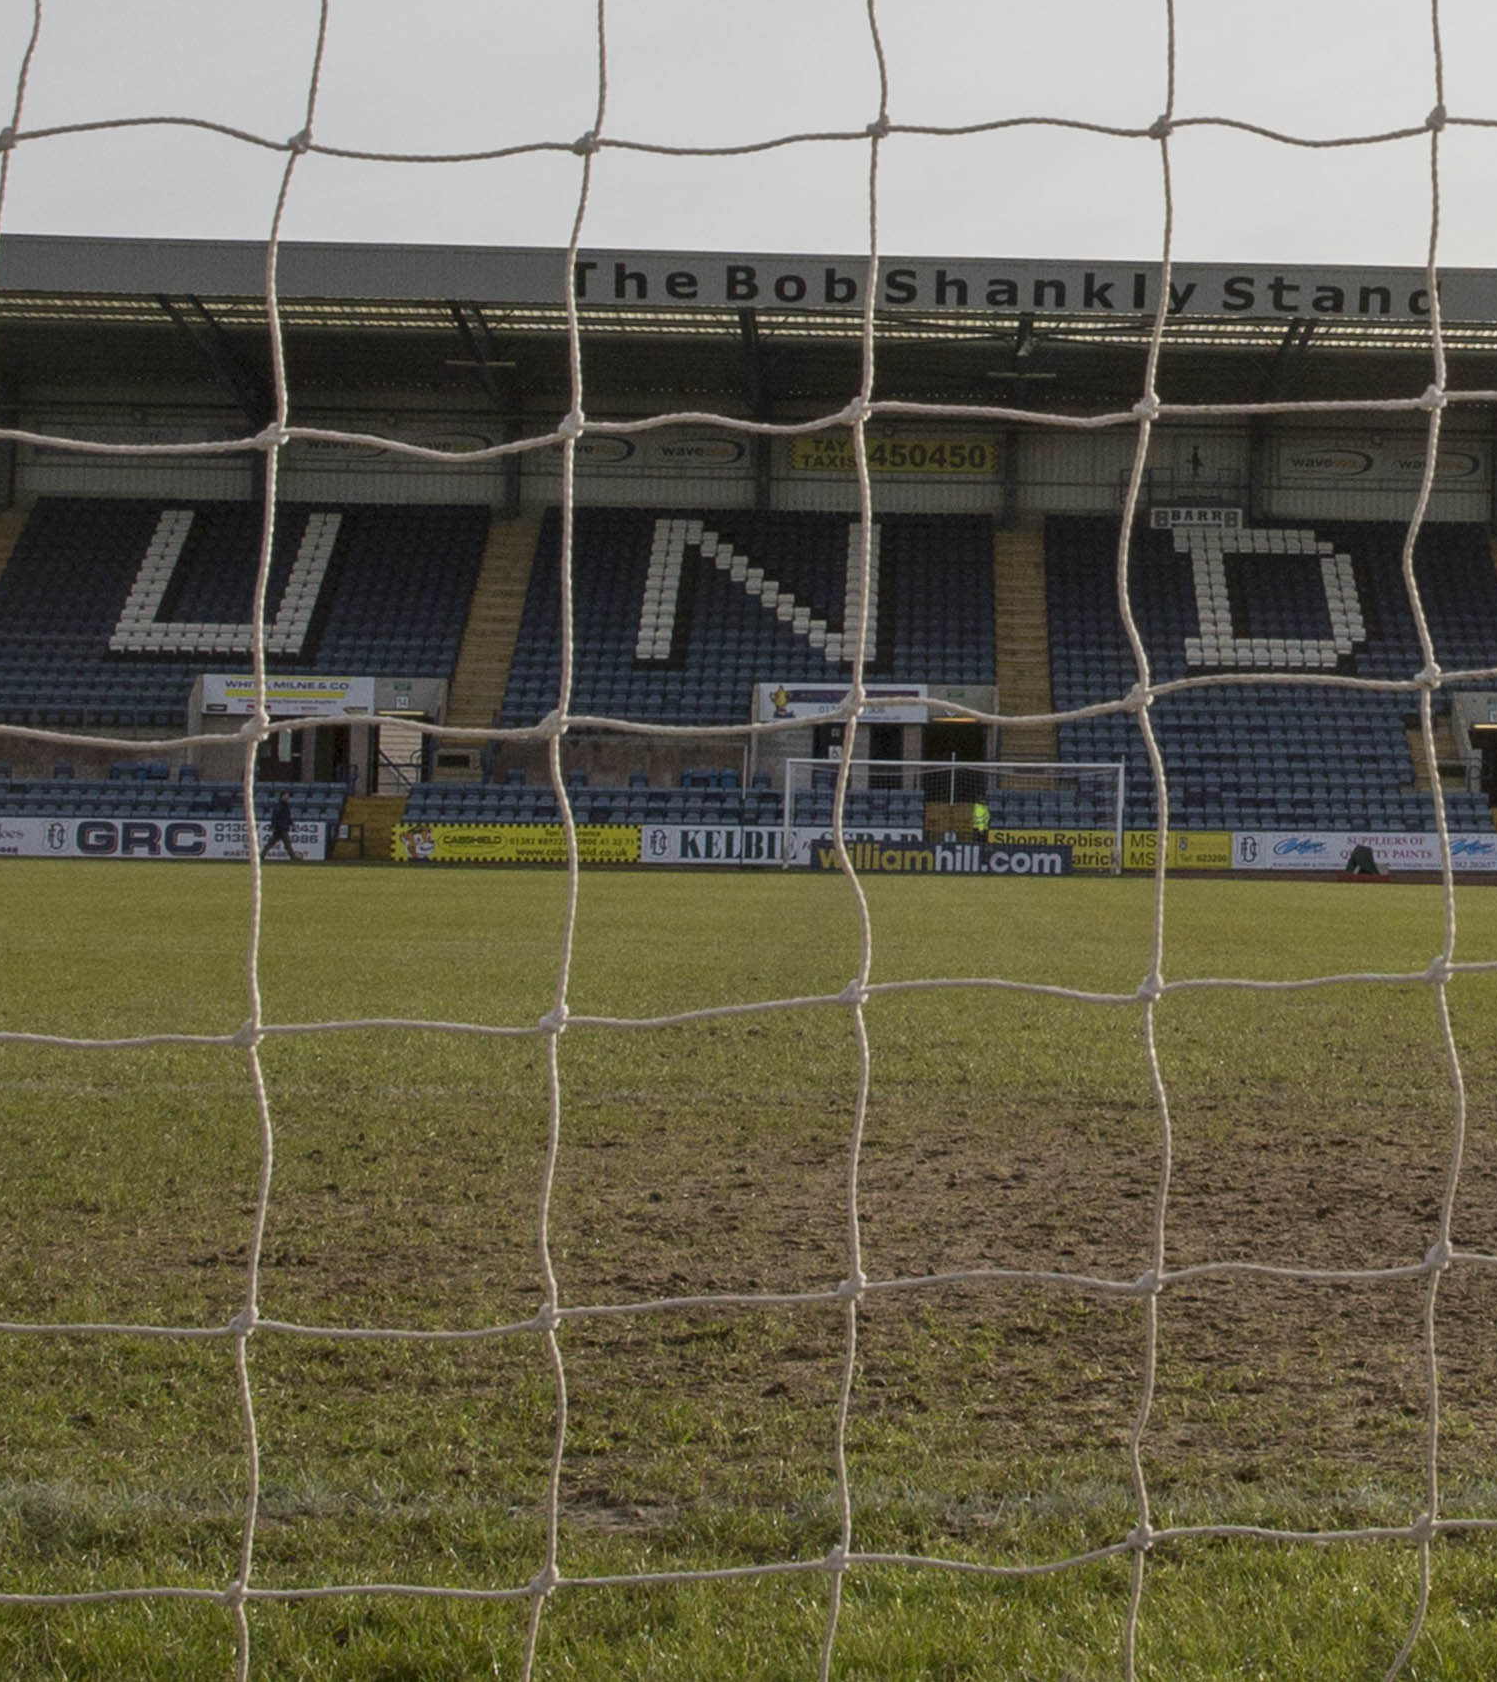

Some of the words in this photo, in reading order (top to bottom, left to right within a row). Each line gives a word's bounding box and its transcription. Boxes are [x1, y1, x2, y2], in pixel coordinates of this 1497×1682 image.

[573, 261, 698, 300] The
[725, 264, 857, 304] Bob
[884, 269, 1197, 315] Shankly
[1222, 275, 1442, 316] Stand
[814, 440, 848, 452] TAY
[801, 454, 858, 469] TAXIS
[869, 444, 987, 469] 450450
[273, 680, 317, 690] MILNE
[75, 820, 208, 857] GRC
[679, 829, 798, 860] KELBIE
[993, 832, 1048, 845] Shona
[1348, 837, 1407, 846] SUPPLIERS
[1409, 837, 1425, 846] OF
[818, 844, 1062, 874] williamhill.com
[1392, 850, 1432, 859] PAINTS
